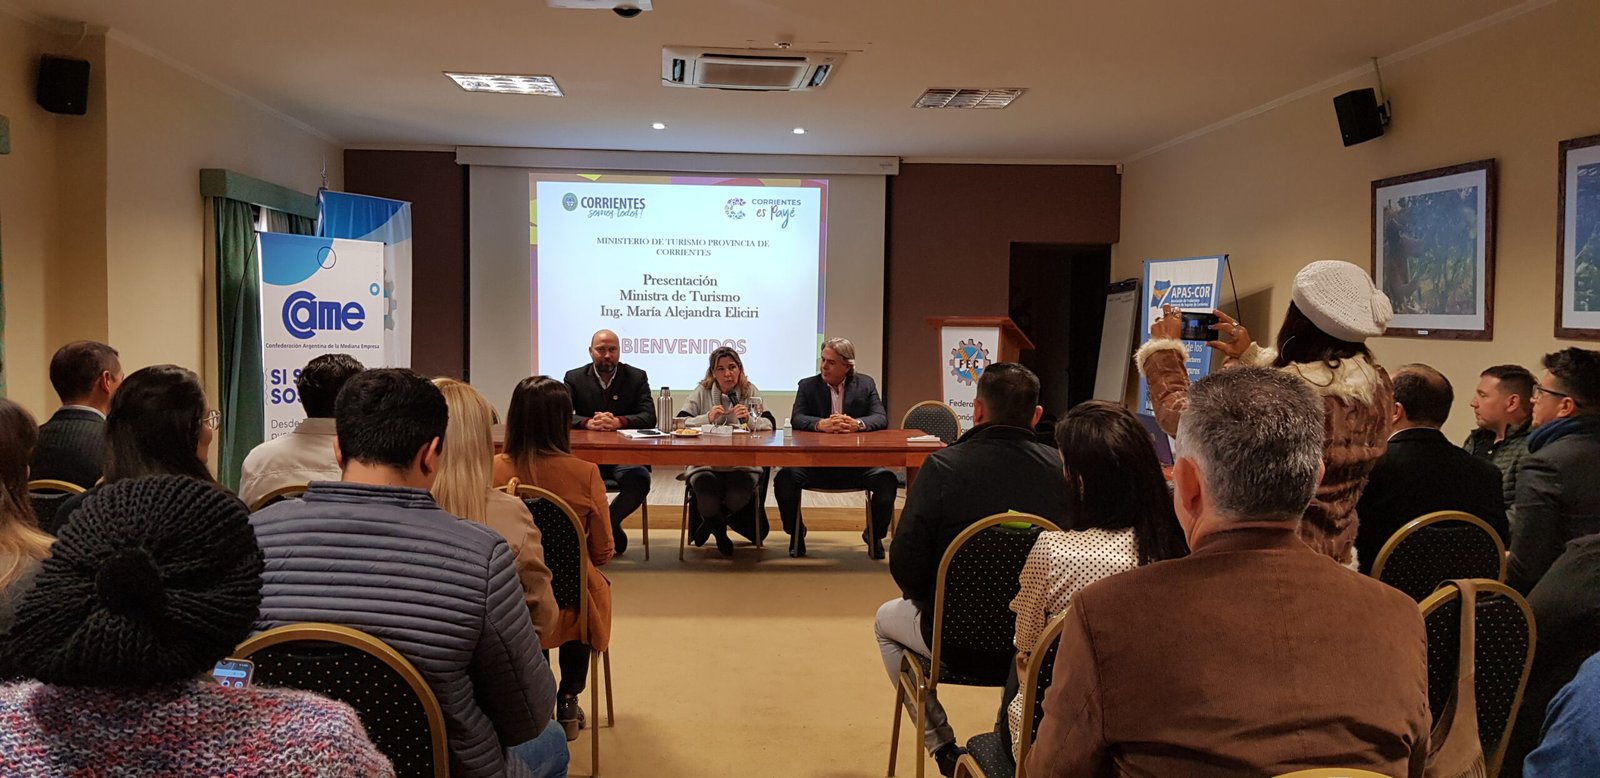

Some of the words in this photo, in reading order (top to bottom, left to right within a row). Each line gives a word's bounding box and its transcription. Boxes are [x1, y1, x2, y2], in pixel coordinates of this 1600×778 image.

[580, 196, 646, 210] CORRIENTES
[751, 198, 802, 206] CORRIENTES
[587, 209, 614, 219] somos
[756, 208, 767, 218] es
[770, 204, 796, 229] Payé
[596, 237, 650, 246] MINISTERIO
[651, 238, 664, 246] DE
[664, 238, 707, 247] TURISMO
[708, 239, 756, 248] PROVINCIA
[757, 240, 771, 248] DE
[656, 248, 712, 257] CORRIENTES
[643, 273, 718, 287] Presentación
[619, 289, 669, 302] Ministra
[671, 290, 687, 302] de
[689, 290, 741, 303] Turismo
[1171, 286, 1211, 299] APAS-COR
[600, 304, 623, 319] Ing.
[627, 305, 661, 318] María
[665, 306, 722, 320] Alejandra
[725, 306, 759, 319] Eliciri
[621, 337, 747, 355] BIENVENIDOS
[1194, 340, 1203, 353] los
[959, 359, 979, 369] FEC
[271, 368, 287, 386] SI
[271, 387, 302, 405] SO
[949, 399, 974, 408] Federa
